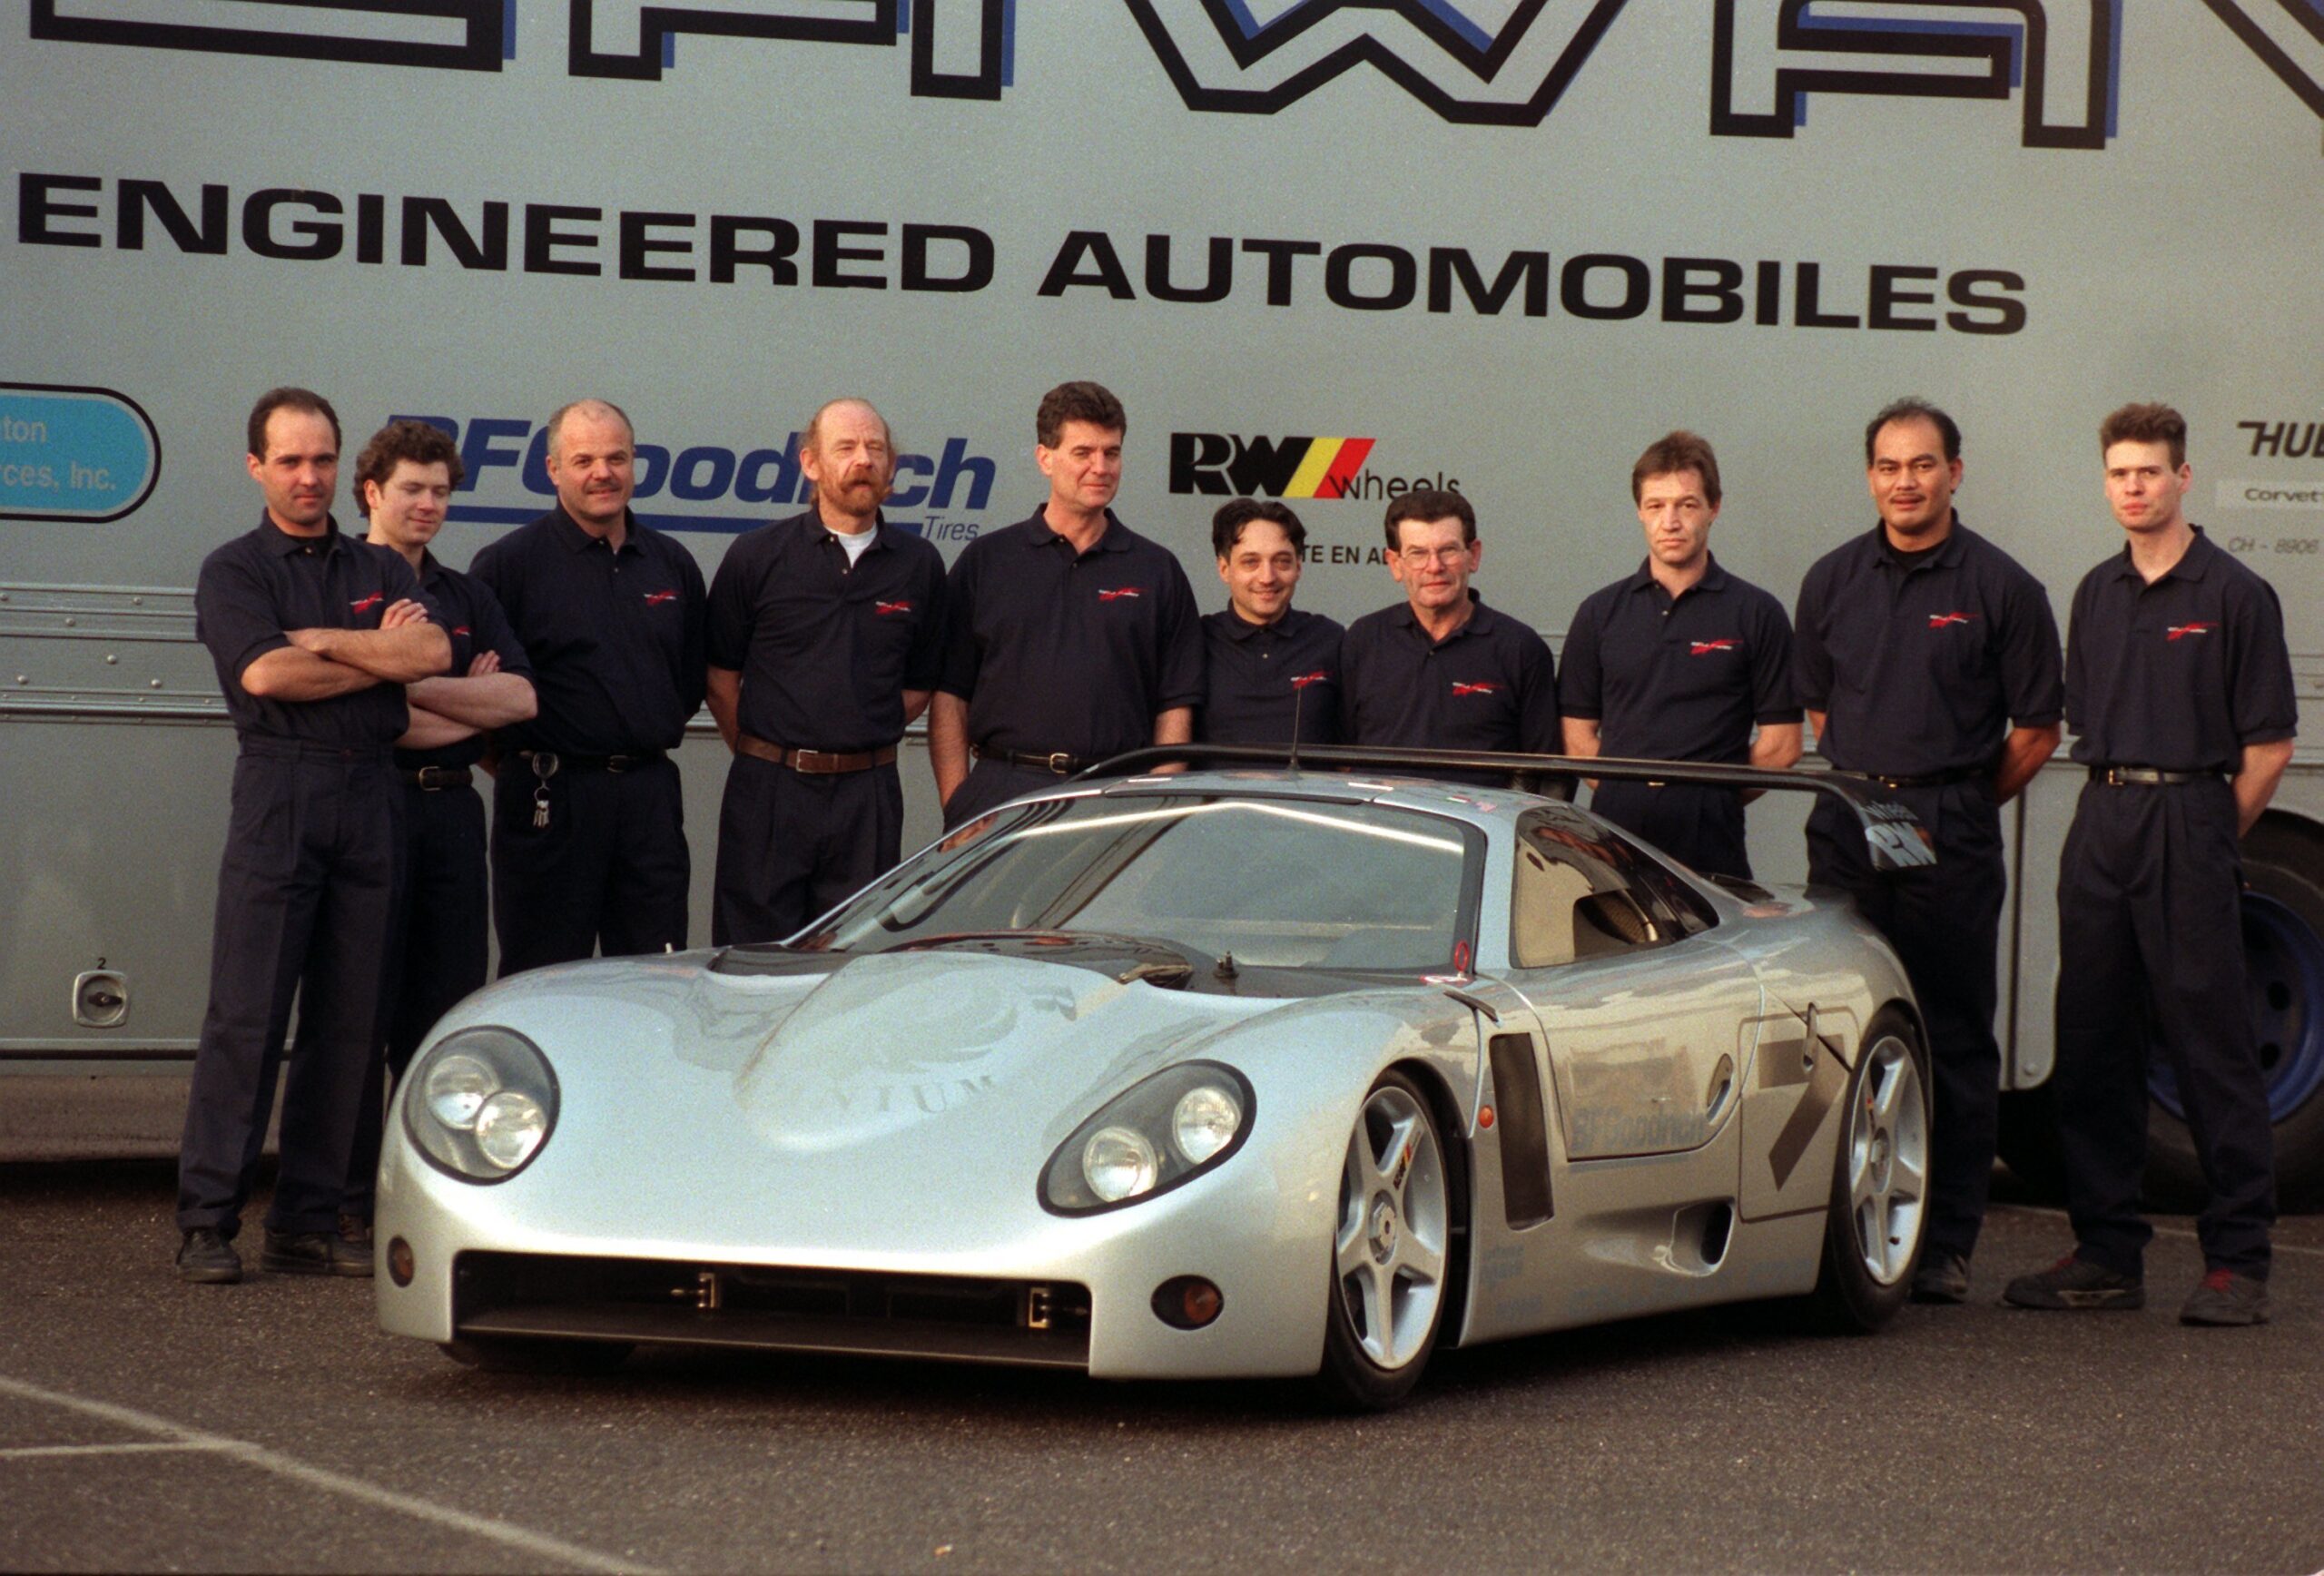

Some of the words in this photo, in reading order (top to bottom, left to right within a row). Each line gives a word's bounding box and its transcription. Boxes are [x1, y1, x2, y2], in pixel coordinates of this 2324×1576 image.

[18, 172, 995, 294] ENGINEERED
[1037, 230, 2027, 335] AUTOMOBILES
[0, 463, 60, 493] ces,
[71, 459, 116, 490] Inc.
[385, 414, 997, 510] Foodch
[1328, 468, 1460, 499] wheels
[2244, 488, 2324, 502] Corvet
[924, 516, 980, 541] Tires
[1331, 546, 1360, 564] EN
[97, 957, 107, 970] 2
